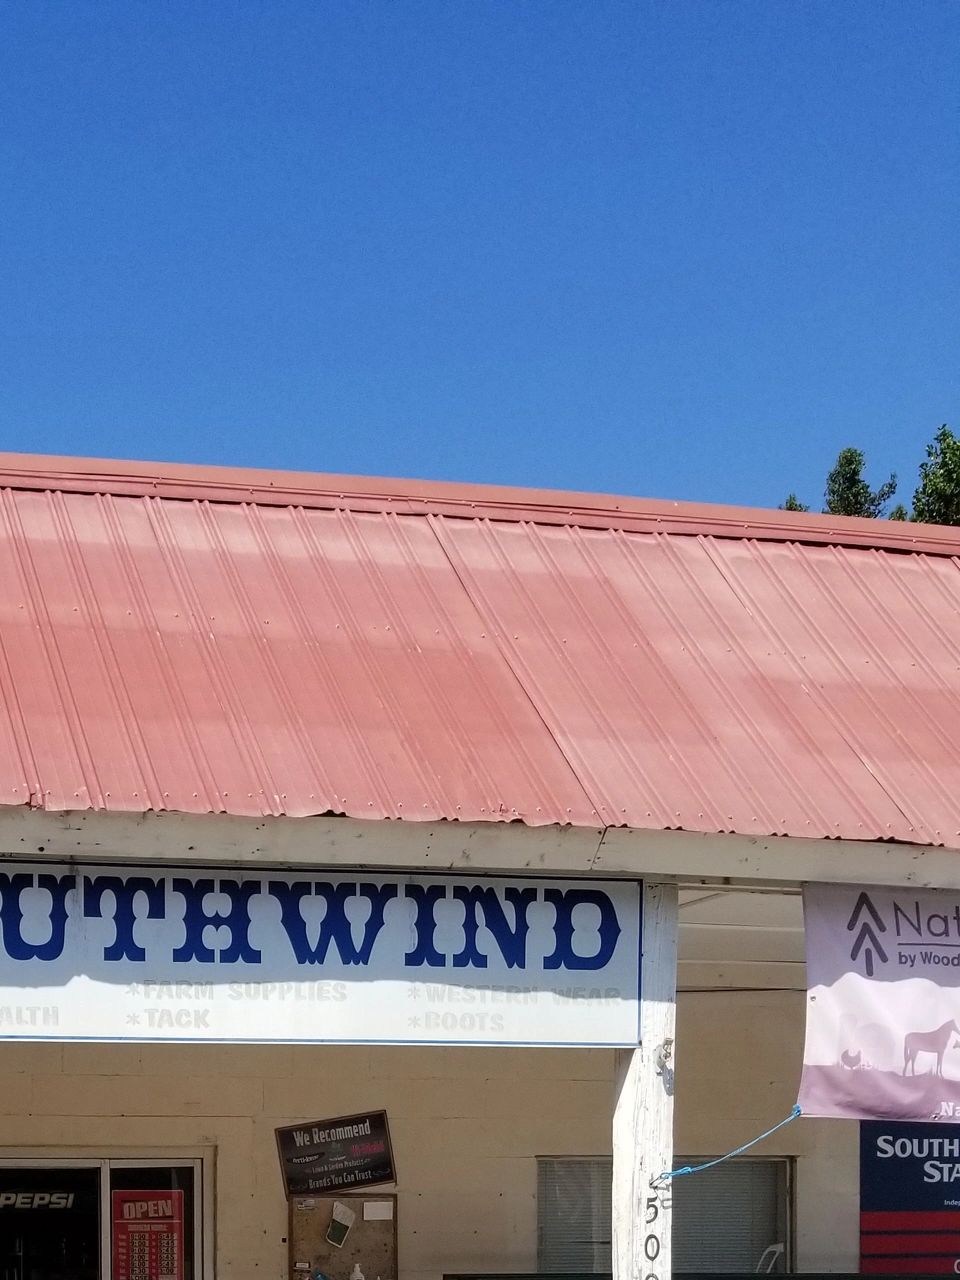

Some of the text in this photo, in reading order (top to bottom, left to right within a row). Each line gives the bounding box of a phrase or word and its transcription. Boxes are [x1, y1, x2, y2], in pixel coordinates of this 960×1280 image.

[898, 951, 917, 967] by
[142, 980, 348, 1002] FARM SUPPLIES
[425, 984, 621, 1006] WESTERN WEAR
[143, 1009, 210, 1029] TACK
[425, 1012, 504, 1032] BOOTS
[292, 1119, 371, 1147] We Recommend
[308, 1170, 372, 1190] Brands You Can Trust
[123, 1199, 173, 1219] OPEN
